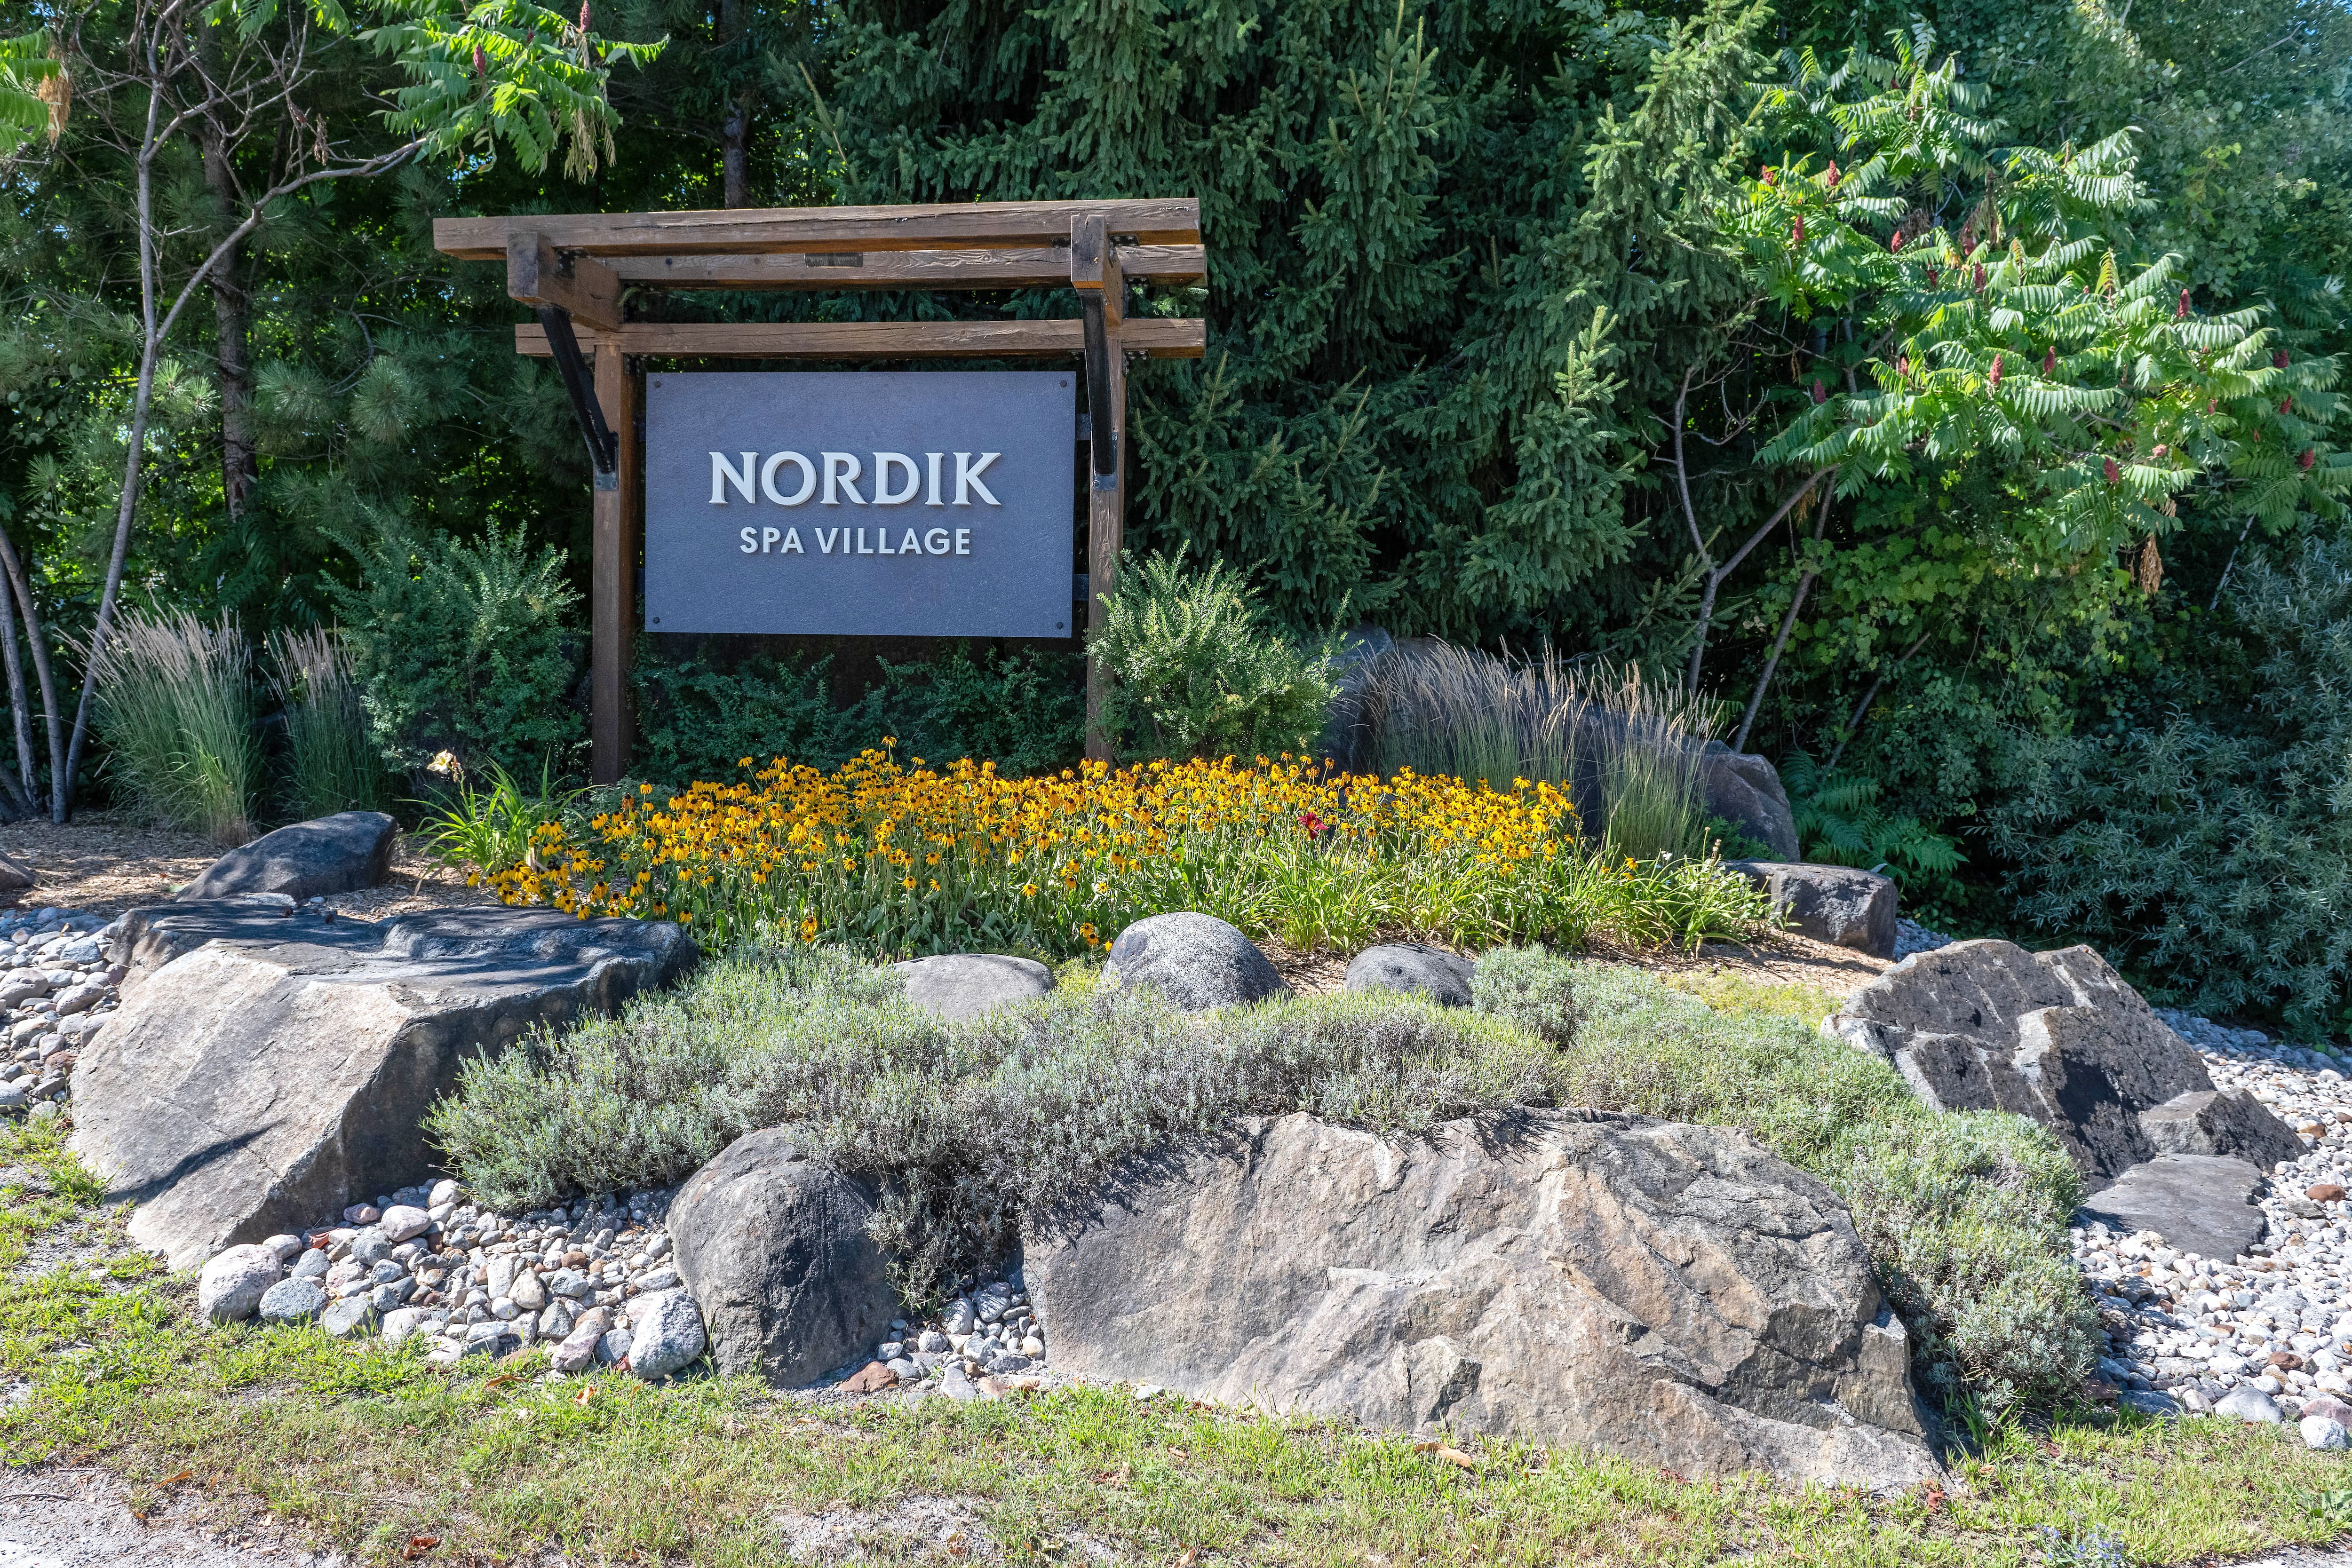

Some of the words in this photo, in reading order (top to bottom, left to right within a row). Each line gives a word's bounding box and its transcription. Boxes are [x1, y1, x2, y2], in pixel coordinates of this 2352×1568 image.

[708, 451, 1002, 506] NORDIK
[740, 527, 805, 554] SPA
[815, 527, 971, 555] VILLAGE
